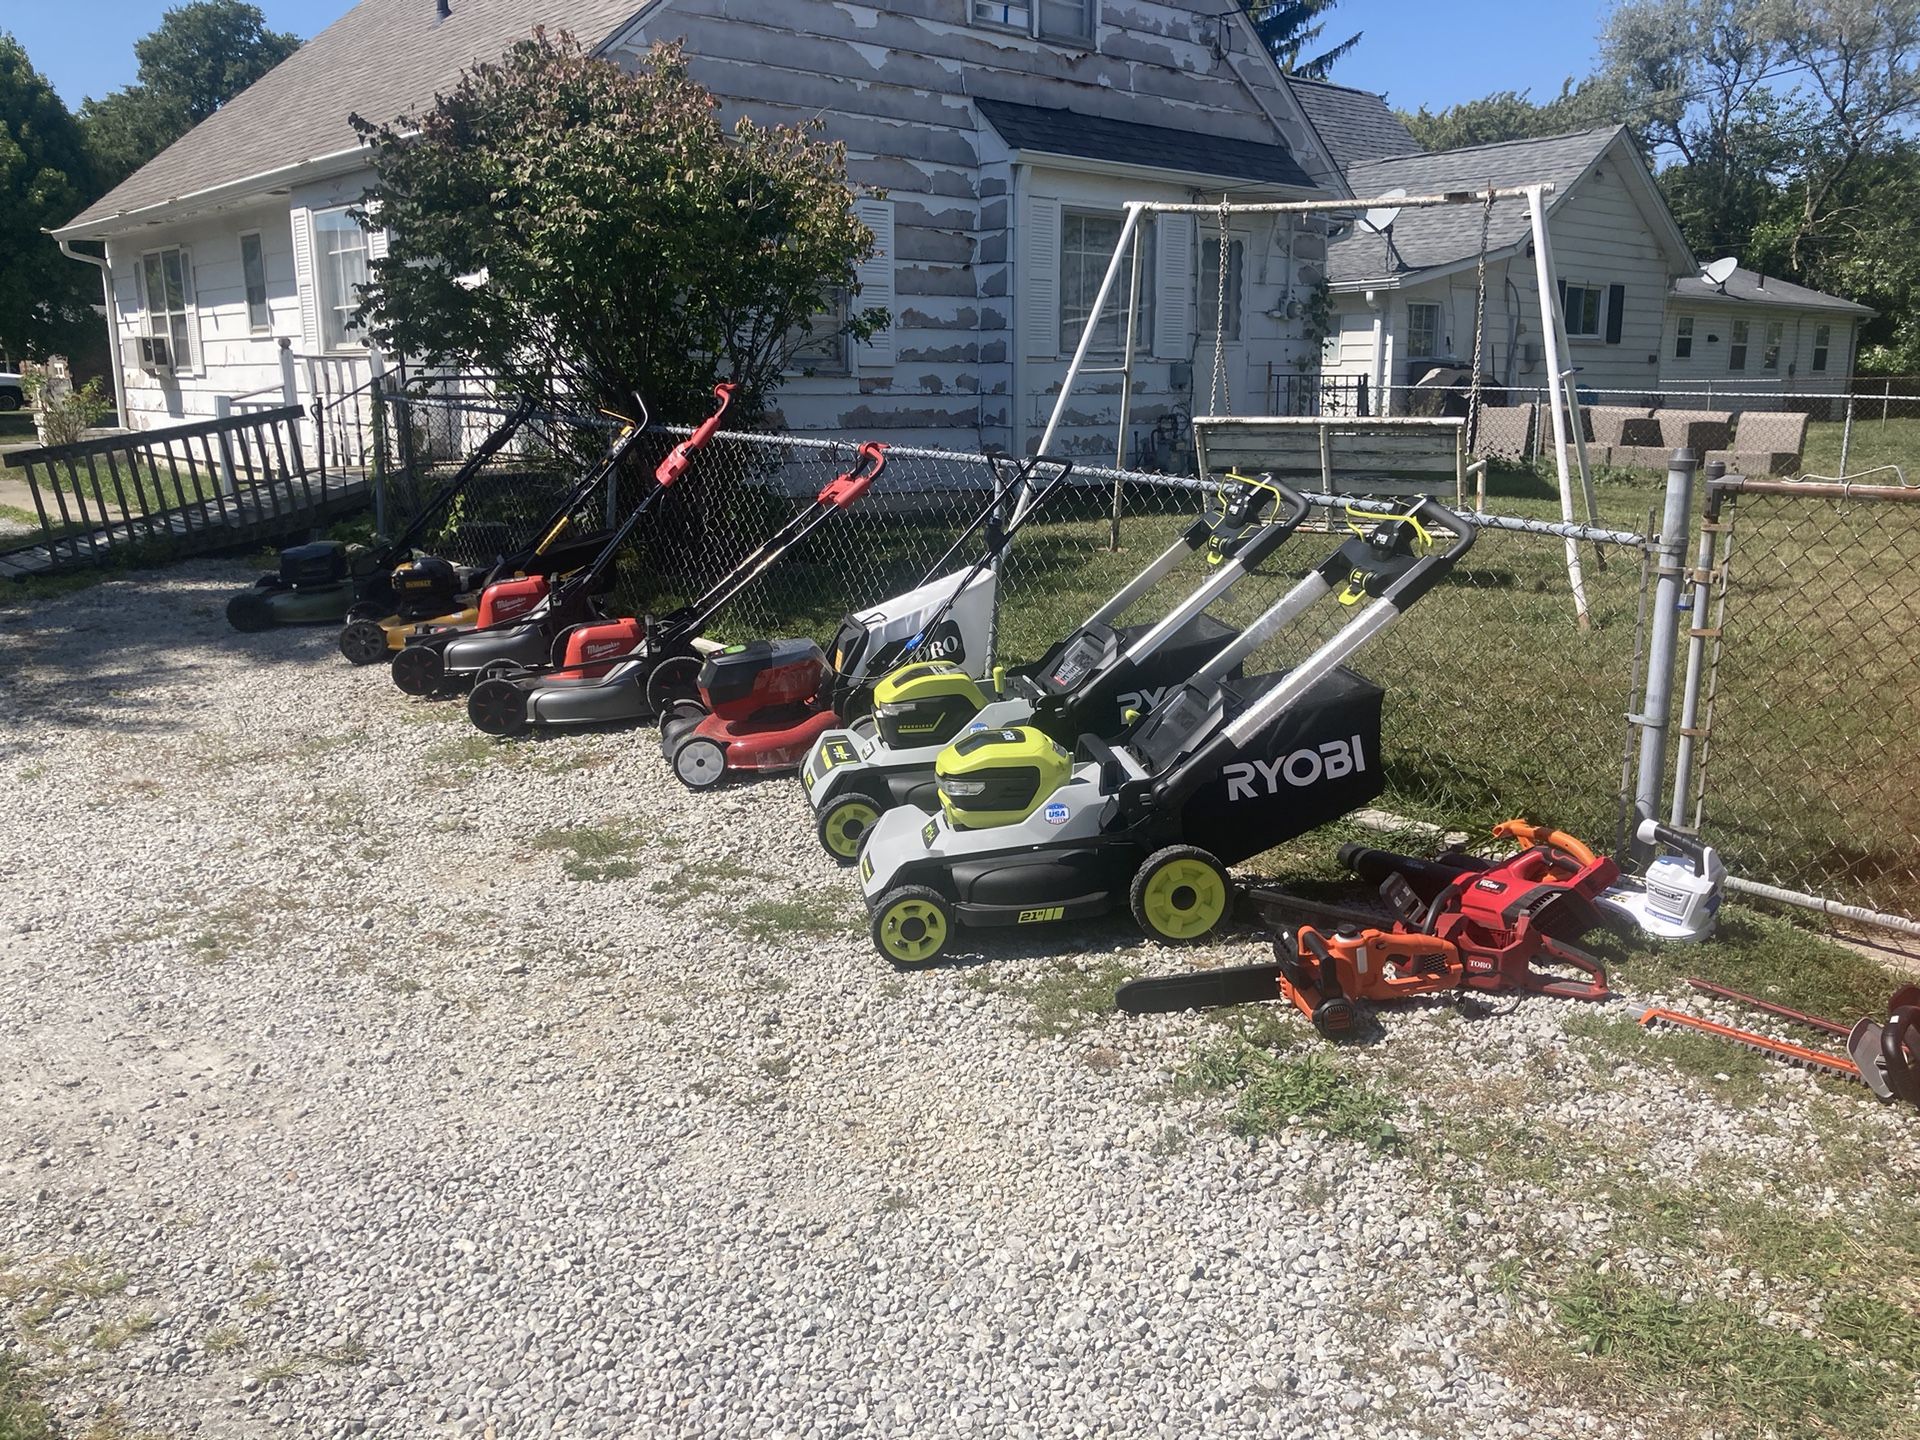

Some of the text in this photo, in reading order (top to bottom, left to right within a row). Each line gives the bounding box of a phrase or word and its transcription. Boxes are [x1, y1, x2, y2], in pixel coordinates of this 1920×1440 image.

[1223, 734, 1366, 802] RYOBI
[1048, 810, 1066, 818] USA
[1470, 960, 1493, 969] TORO
